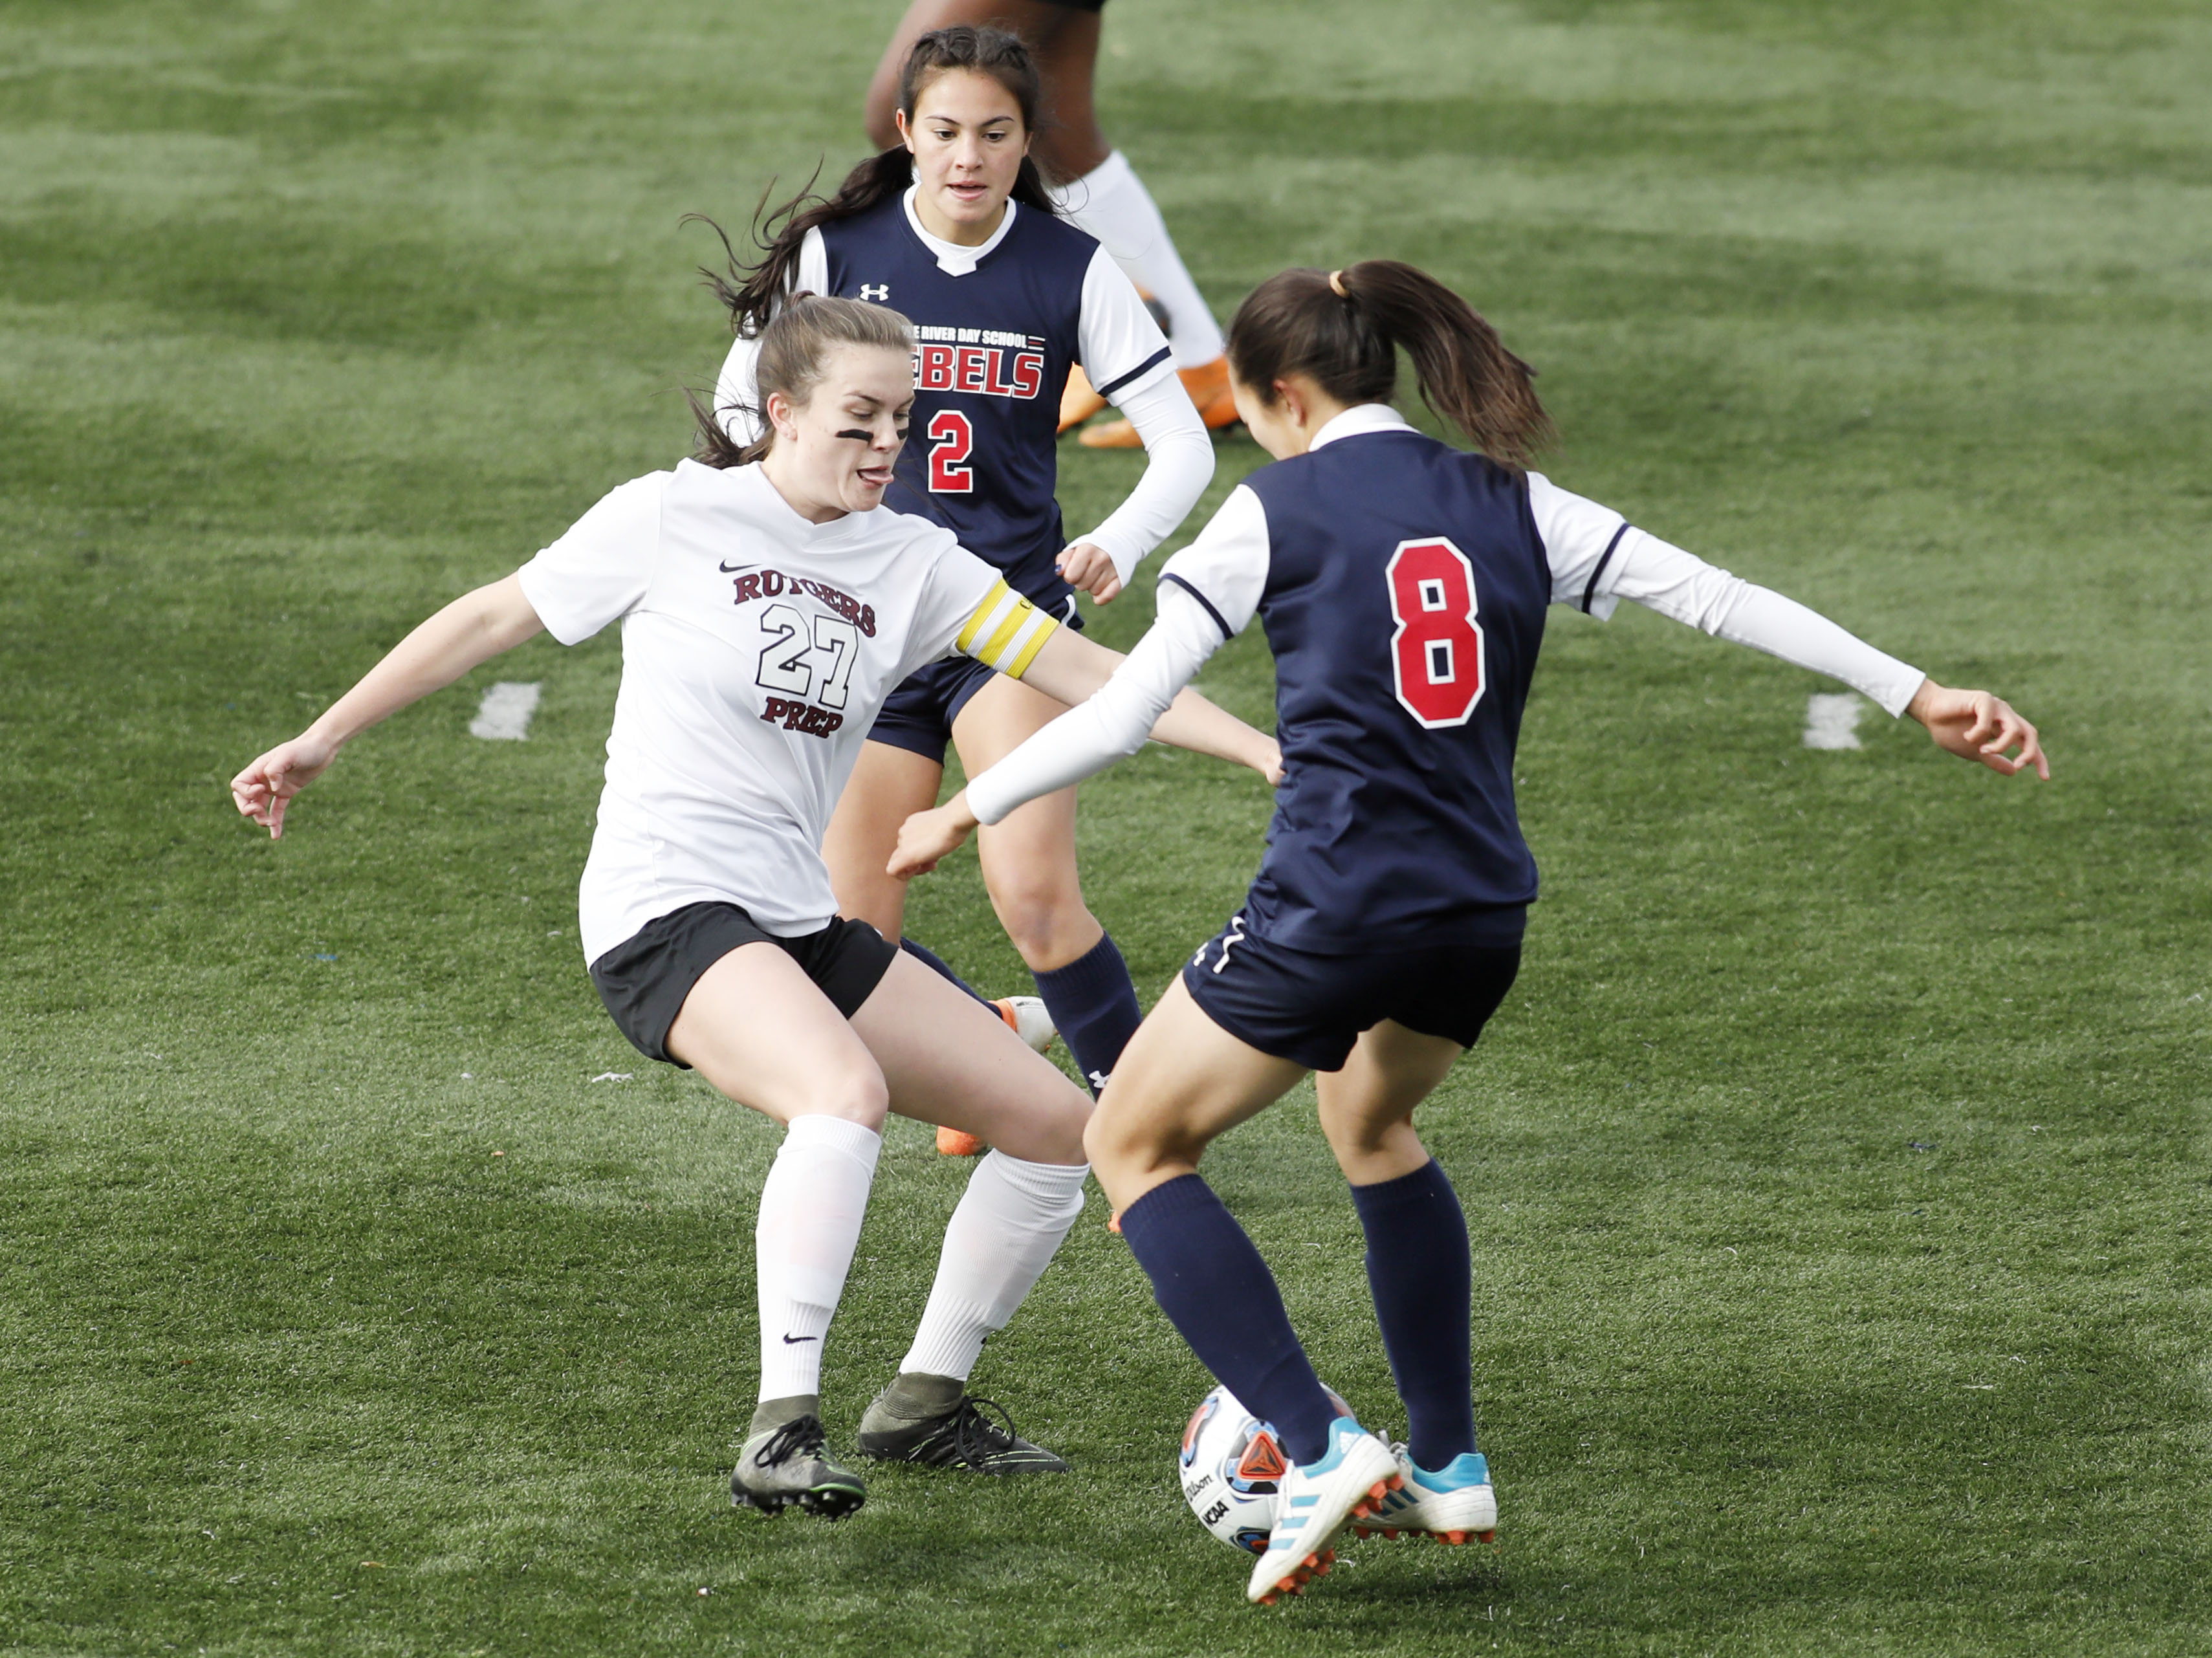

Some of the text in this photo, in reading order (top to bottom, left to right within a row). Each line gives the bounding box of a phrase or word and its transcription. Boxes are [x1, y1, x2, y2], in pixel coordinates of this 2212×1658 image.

[921, 325, 956, 341] RIVER
[958, 328, 981, 343] DAY
[982, 330, 1027, 349] SCHOOL
[911, 343, 1044, 400] BELS
[927, 409, 973, 493] 2
[733, 569, 876, 638] RUTGERS
[1385, 536, 1486, 730] 8
[755, 604, 859, 710] 27
[760, 696, 844, 739] PREP
[1201, 1500, 1231, 1527] NCAA
